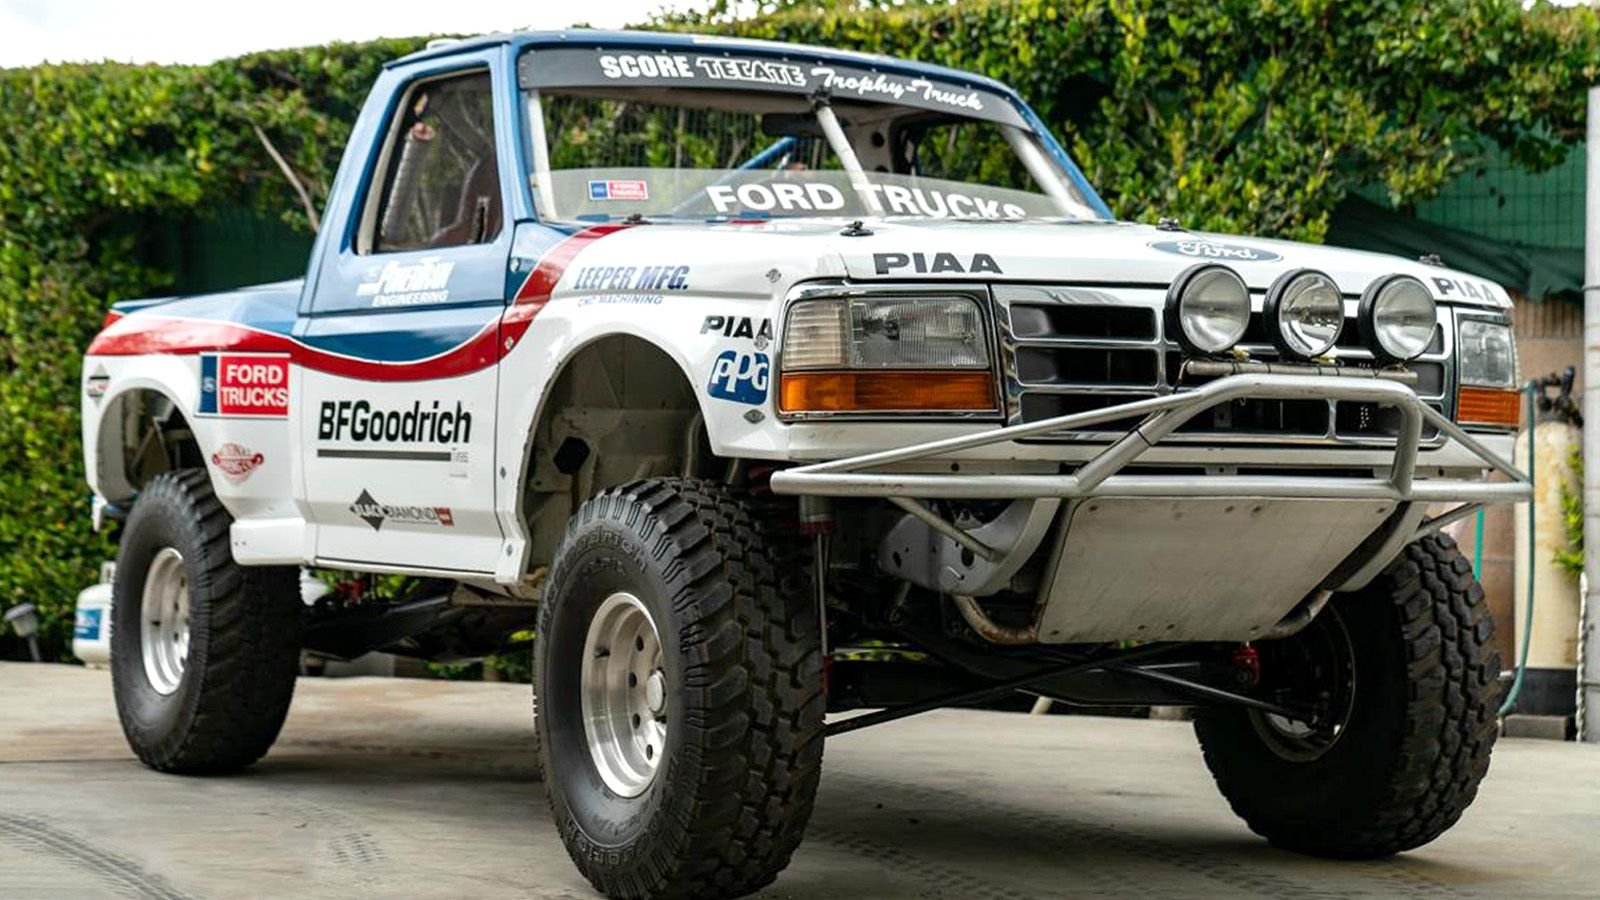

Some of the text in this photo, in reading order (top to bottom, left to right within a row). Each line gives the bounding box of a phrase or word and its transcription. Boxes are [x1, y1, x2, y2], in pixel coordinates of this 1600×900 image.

[600, 55, 984, 111] SCORE TECATE Trophy-Truck
[706, 183, 845, 213] FORD
[1176, 240, 1259, 259] Ford
[872, 252, 1004, 276] PIAA
[574, 265, 690, 291] LEEPER MFG.
[1430, 277, 1499, 304] PIAA
[599, 294, 665, 305] MACHINING
[699, 315, 774, 340] PIAA
[226, 365, 283, 384] FORD
[711, 350, 769, 394] PPG
[221, 386, 289, 407] TRUCKS
[318, 400, 472, 444] BFGoodrich
